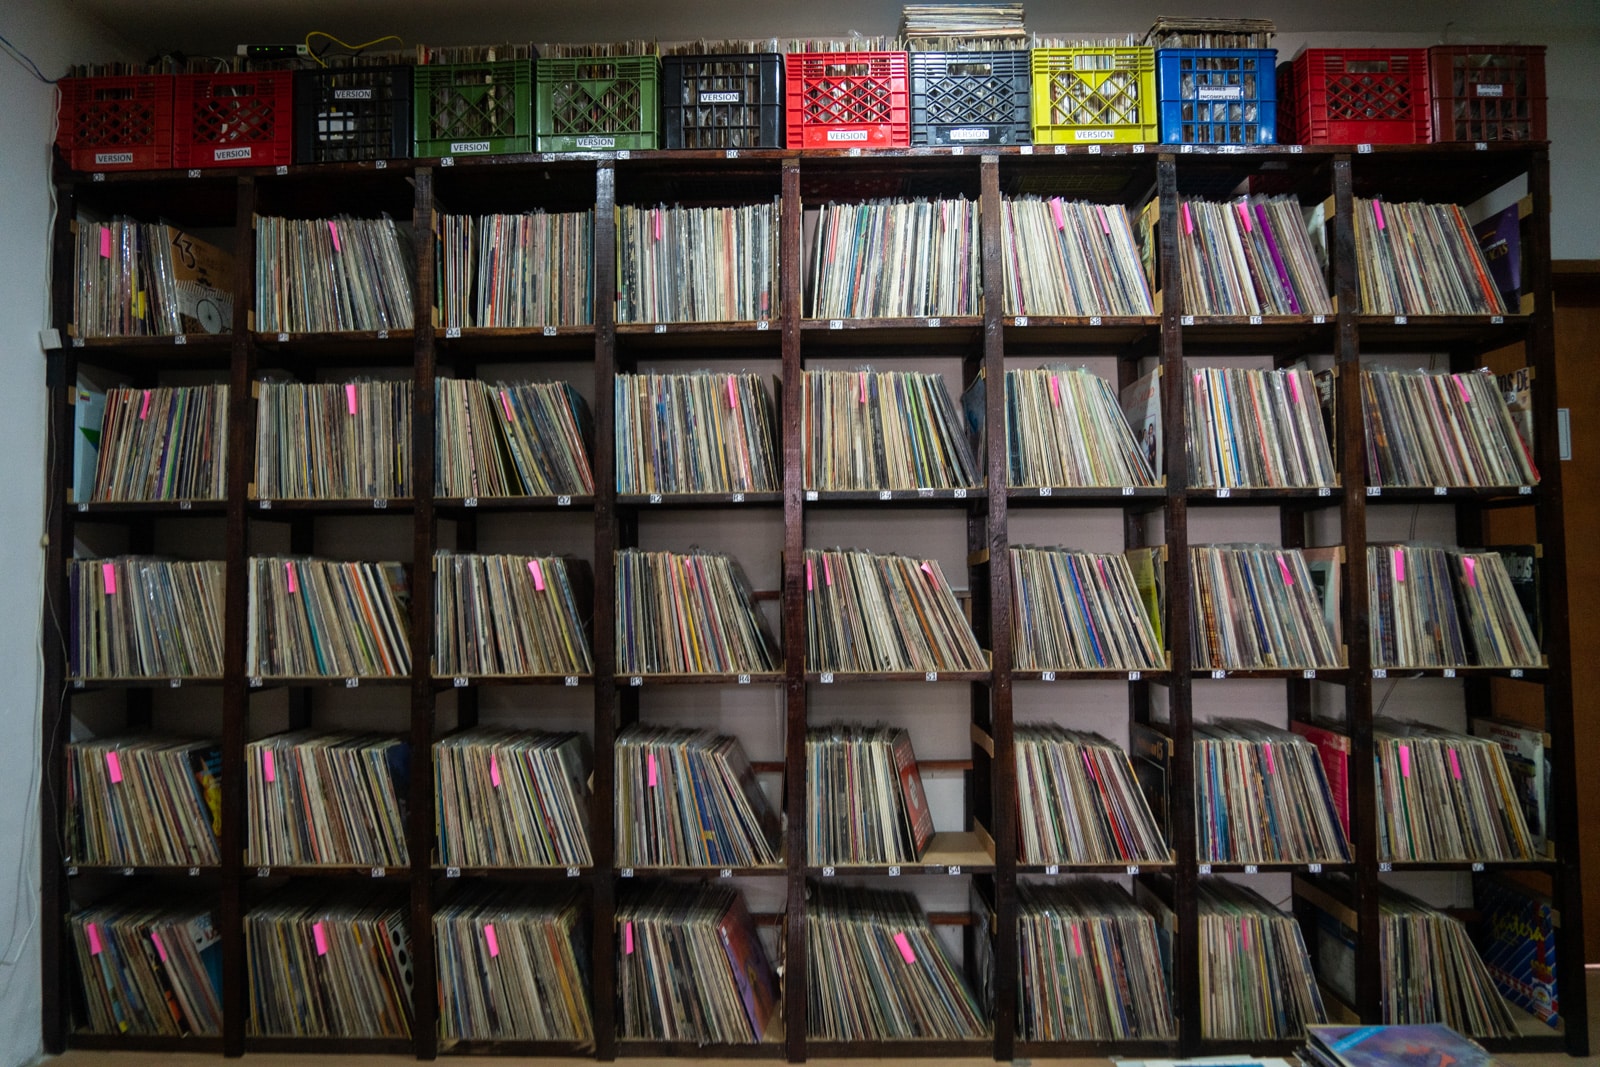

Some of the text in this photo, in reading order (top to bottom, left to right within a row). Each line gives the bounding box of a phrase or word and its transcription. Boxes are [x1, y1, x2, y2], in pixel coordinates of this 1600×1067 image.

[336, 90, 370, 98] VERSION
[702, 93, 738, 101] VERSION
[951, 130, 989, 138] VERSION
[1077, 131, 1113, 139] VERSION
[578, 138, 614, 146] VERSION
[452, 143, 489, 151] VERSION
[216, 149, 250, 159] VERSION
[98, 154, 132, 163] VERSION
